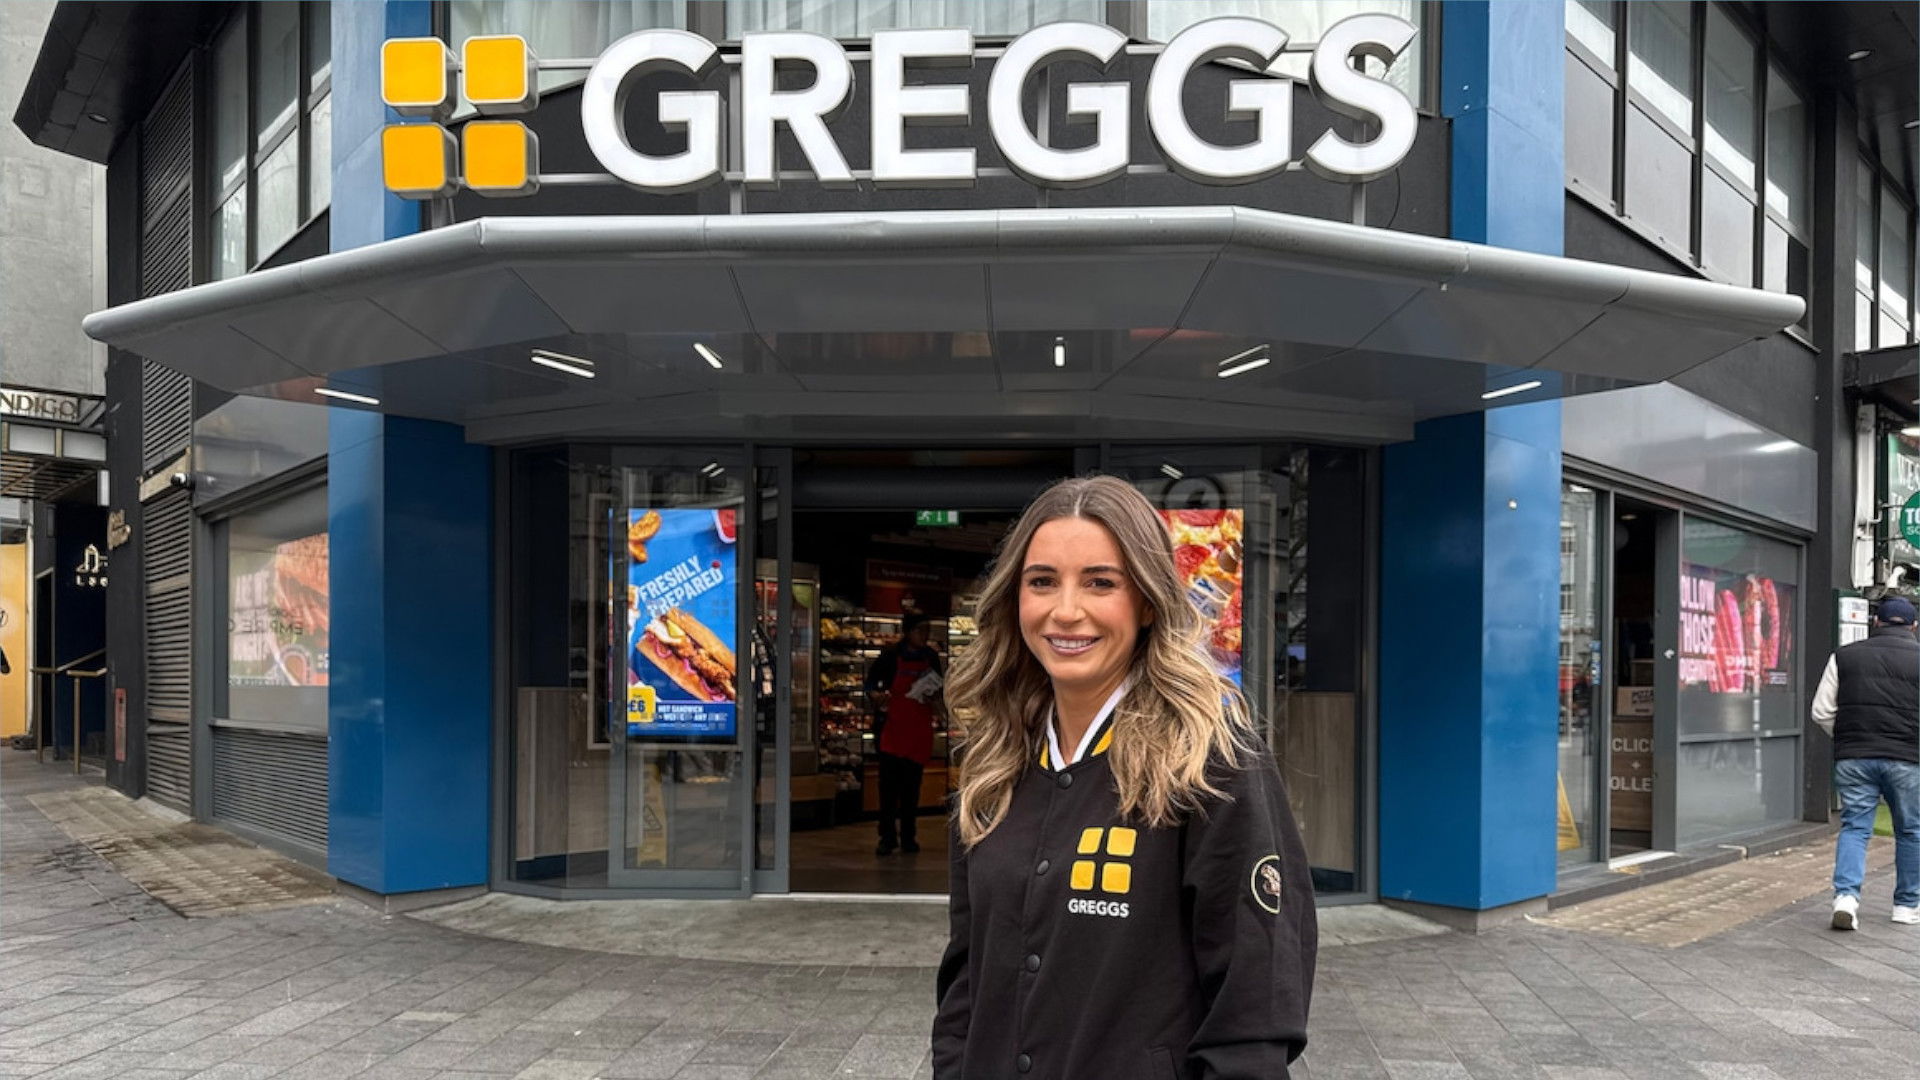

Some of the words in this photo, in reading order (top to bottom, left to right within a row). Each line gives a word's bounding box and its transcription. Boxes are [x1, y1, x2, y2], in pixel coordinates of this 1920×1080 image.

[580, 13, 1420, 192] GREGGS
[0, 392, 77, 417] NDIGO
[640, 555, 702, 601] FRESHLY
[647, 567, 724, 619] PREPARED
[630, 700, 646, 712] £6
[1612, 738, 1654, 752] CLIC
[1610, 776, 1652, 792] OLLE
[1068, 898, 1130, 918] GREGGS
